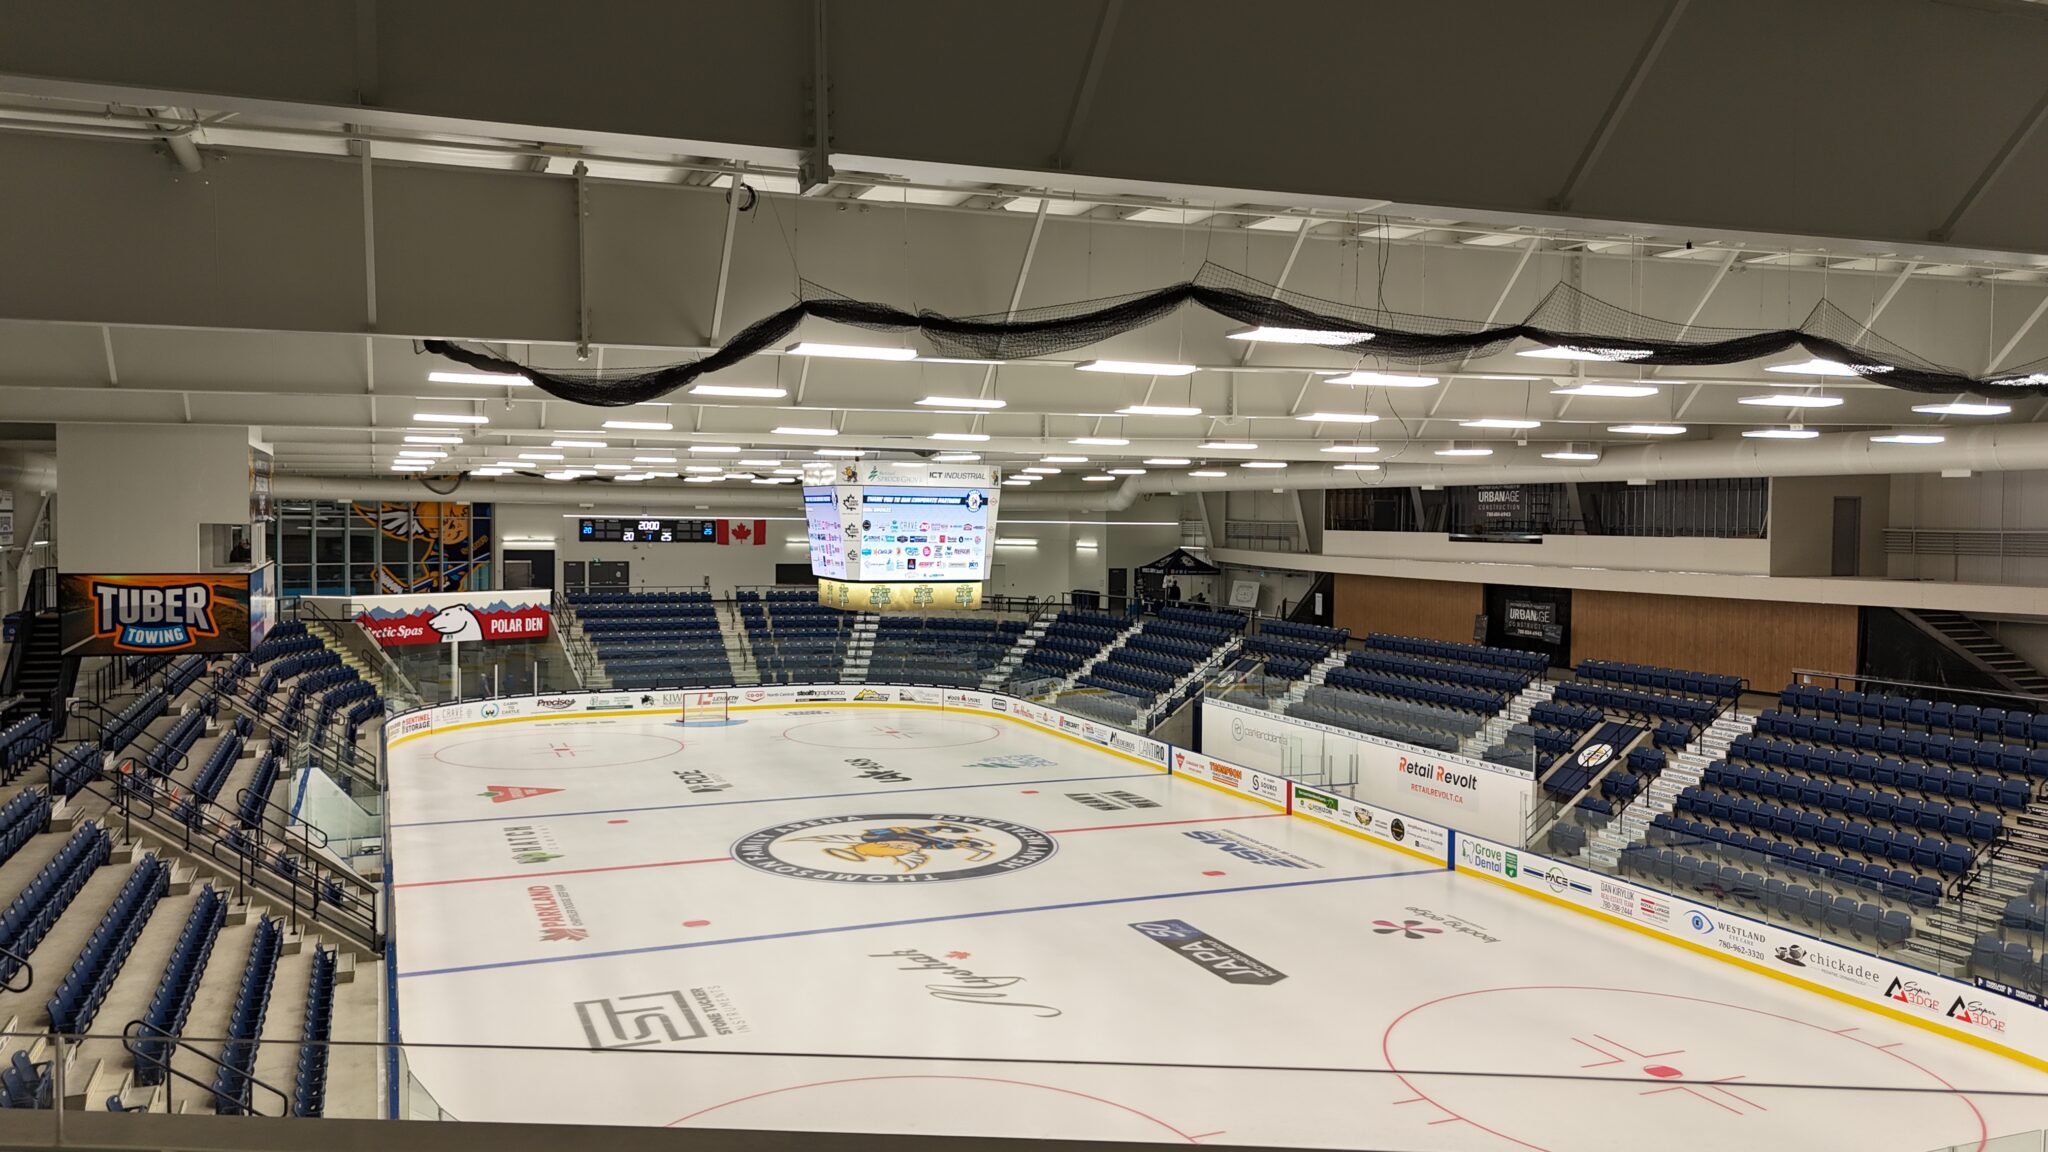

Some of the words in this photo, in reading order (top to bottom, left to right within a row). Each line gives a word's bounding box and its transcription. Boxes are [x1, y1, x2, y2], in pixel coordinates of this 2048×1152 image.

[944, 472, 985, 480] INDUSTRIAL
[1478, 490, 1520, 502] URBANAGE
[623, 532, 634, 541] 20
[96, 585, 209, 631] TUBER
[1509, 607, 1550, 623] URBANAGE
[398, 625, 424, 638] Spas
[491, 618, 523, 633] POLAR
[525, 617, 543, 632] DEN
[127, 627, 184, 644] TOWING
[537, 698, 571, 708] Precise
[406, 713, 430, 725] SENTINEL
[406, 721, 431, 733] STORAGE
[1399, 757, 1433, 779] Retail
[1436, 766, 1477, 790] Revolt
[1410, 783, 1463, 804] RETAILREVOLT.CA
[773, 816, 865, 833] ARENA
[928, 814, 1010, 829] PLACE
[503, 825, 543, 853] HATCH
[1001, 825, 1049, 846] METAL
[740, 832, 774, 861] FAMILY
[1181, 831, 1267, 861] SMS
[1475, 843, 1502, 861] Grove
[998, 845, 1049, 869] HEAVY
[1475, 856, 1502, 873] Dental
[757, 859, 940, 883] THOMPSON
[1545, 872, 1568, 887] PACE
[1601, 882, 1613, 894] DAN
[527, 885, 567, 928] PARKLAND
[1623, 898, 1634, 909] TEAM
[1405, 906, 1444, 922] edge
[1136, 923, 1185, 938] 50
[1443, 920, 1501, 944] leading
[1718, 921, 1766, 944] WESTLAND
[1202, 939, 1231, 955] GROUP
[1718, 939, 1765, 961] 780-962-3320
[1180, 940, 1266, 978] JAPA
[1230, 949, 1277, 977] MACHINERY
[1809, 952, 1880, 983] chickadee
[868, 949, 1063, 1019] Myshak
[1903, 980, 1931, 997] Super
[690, 987, 717, 1013] TUCKER
[707, 985, 752, 1033] INSTRUMENTS
[1967, 1000, 1996, 1018] Super
[706, 1012, 734, 1035] STONE
